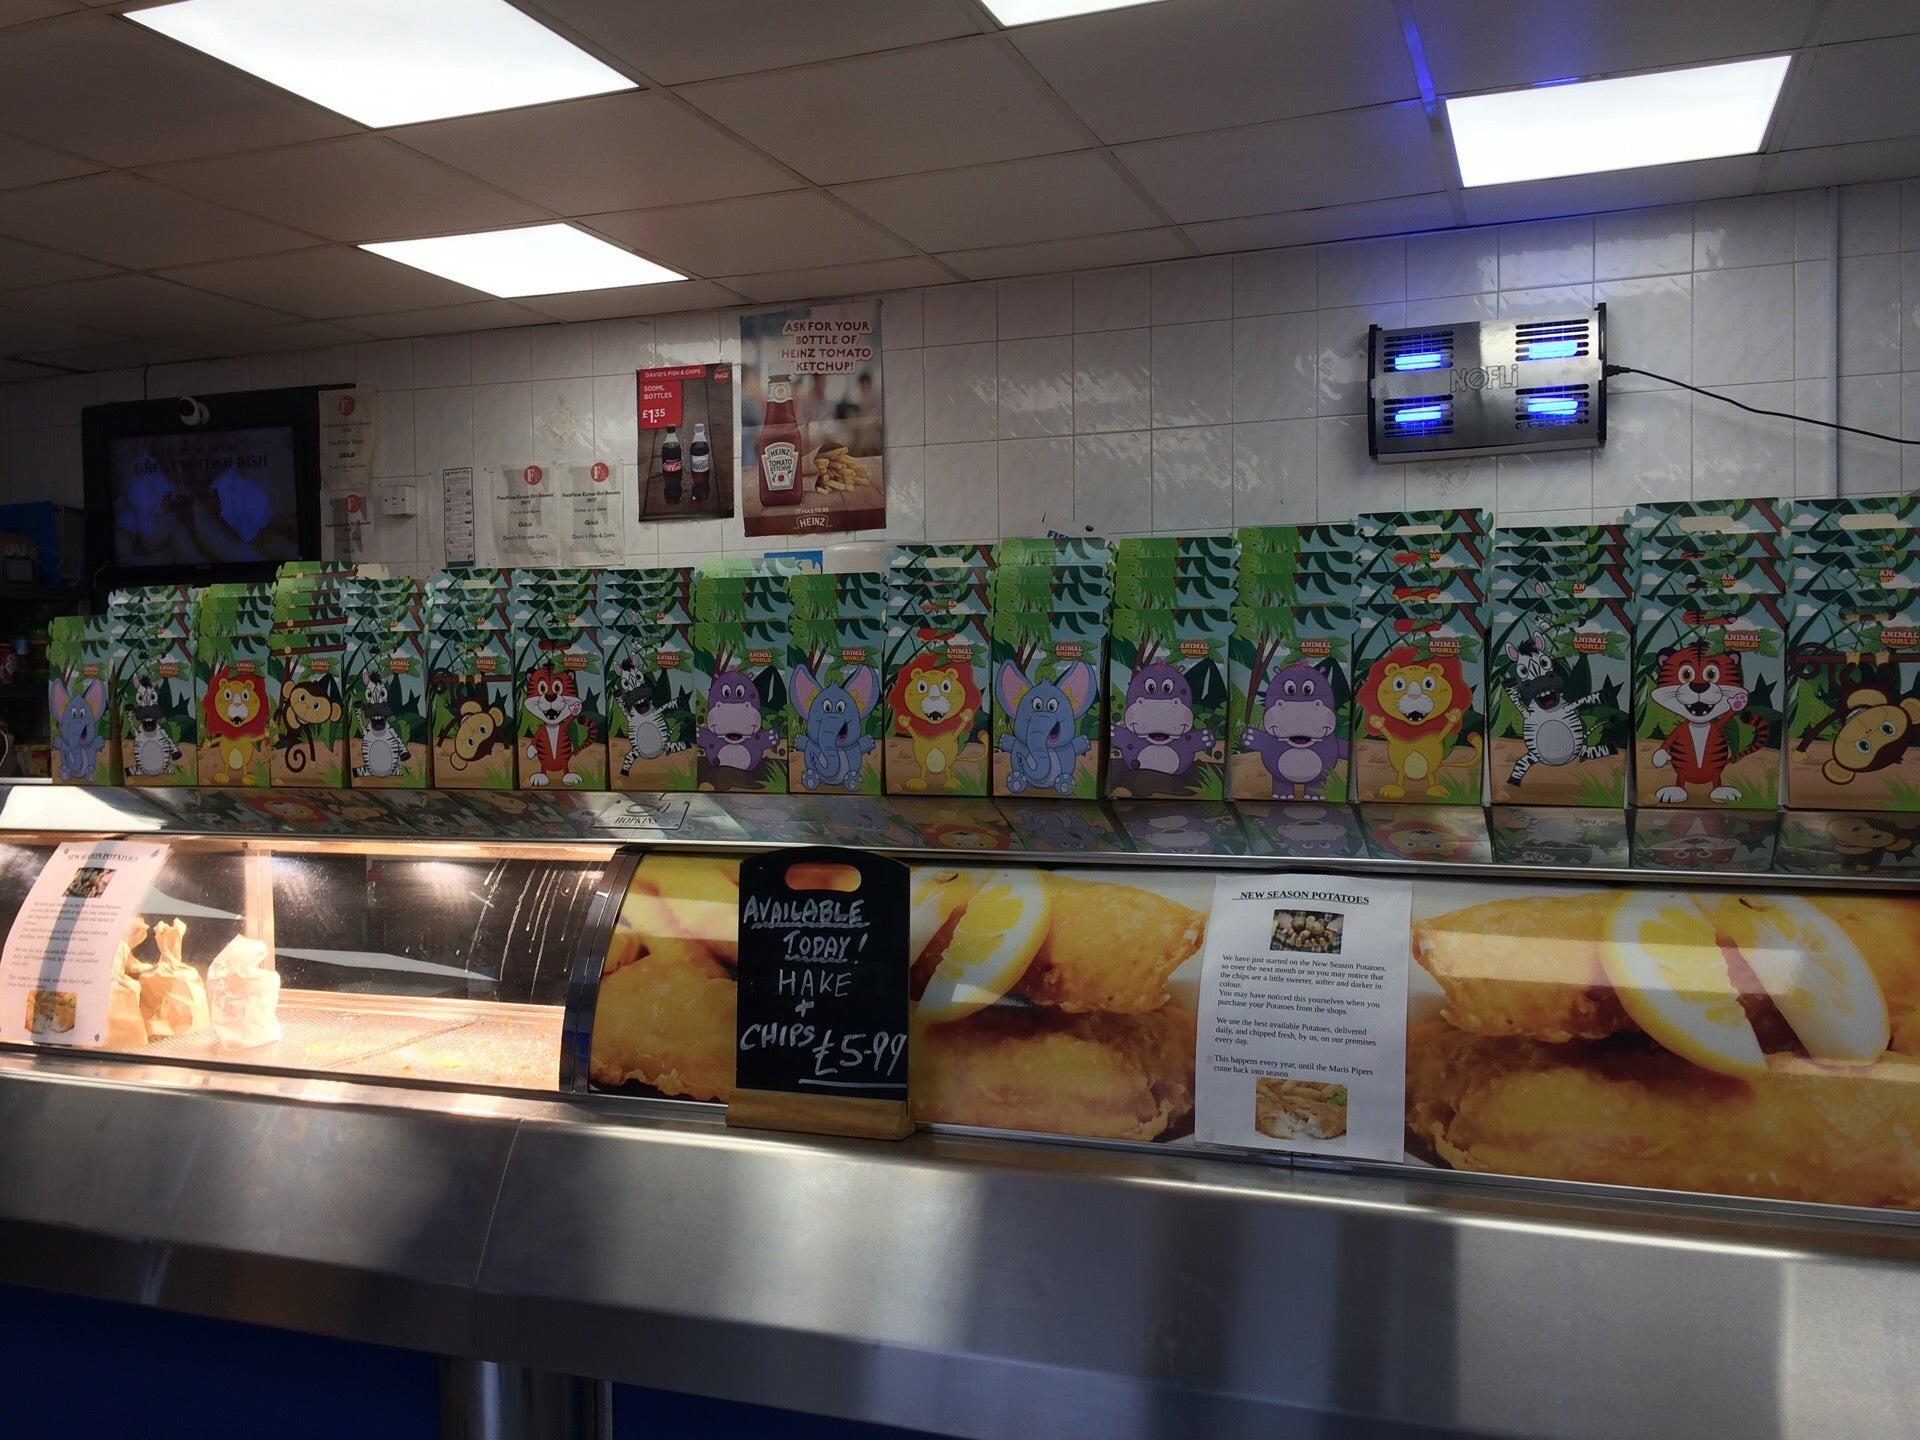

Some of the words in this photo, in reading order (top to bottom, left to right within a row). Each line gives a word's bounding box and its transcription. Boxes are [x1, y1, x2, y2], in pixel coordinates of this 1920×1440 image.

[784, 322, 806, 332] ASK
[808, 322, 832, 331] FOR
[836, 321, 870, 331] YOUR
[796, 335, 838, 345] BOTTLE
[842, 335, 857, 344] OF
[782, 348, 816, 358] HEINZ
[819, 348, 871, 358] TOMATO
[796, 362, 854, 371] KETCHUP!
[644, 392, 672, 400] BOTTLES
[770, 448, 790, 457] HEINZ
[769, 458, 792, 466] TOMATO
[799, 516, 826, 528] HEINZ
[1881, 631, 1919, 639] ANIMAL
[1240, 891, 1264, 899] NEW
[1267, 890, 1309, 899] SEASON
[1312, 891, 1370, 904] POTATOES
[742, 895, 865, 924] AVAILABLE
[783, 930, 868, 964] TODAY!
[1330, 961, 1354, 969] Season
[1232, 972, 1249, 981] chips
[778, 968, 852, 998] HAKE
[1266, 1002, 1294, 1010] Potatoes
[1269, 1022, 1300, 1030] available
[1334, 1026, 1367, 1035] delivered
[740, 1022, 816, 1050] CHIPS
[1215, 1037, 1233, 1045] every
[1249, 1030, 1276, 1038] chipped
[1298, 1033, 1307, 1042] by
[1344, 1038, 1376, 1046] premises
[1230, 1056, 1258, 1065] happens
[1259, 1060, 1278, 1068] every
[1329, 1065, 1349, 1073] Maris
[1351, 1067, 1374, 1076] Pipers
[1250, 1067, 1264, 1075] into
